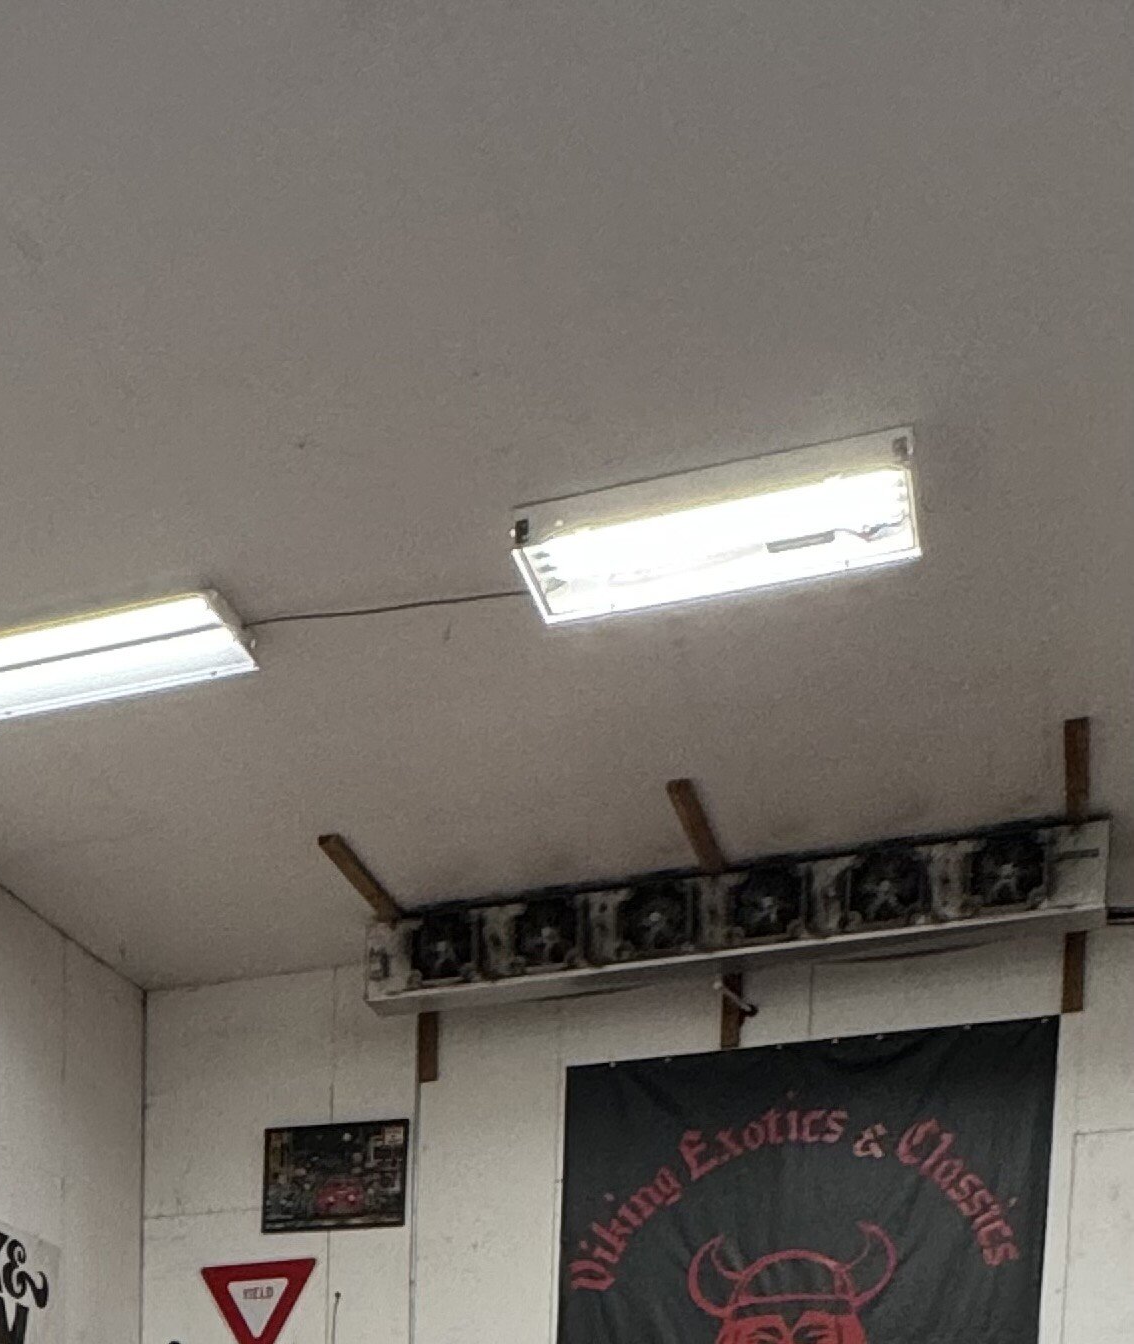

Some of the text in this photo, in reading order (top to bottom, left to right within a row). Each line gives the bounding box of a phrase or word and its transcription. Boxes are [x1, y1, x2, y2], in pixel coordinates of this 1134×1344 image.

[568, 1090, 1020, 1291] Viking Exotics & Classics
[243, 1286, 274, 1300] YIELD
